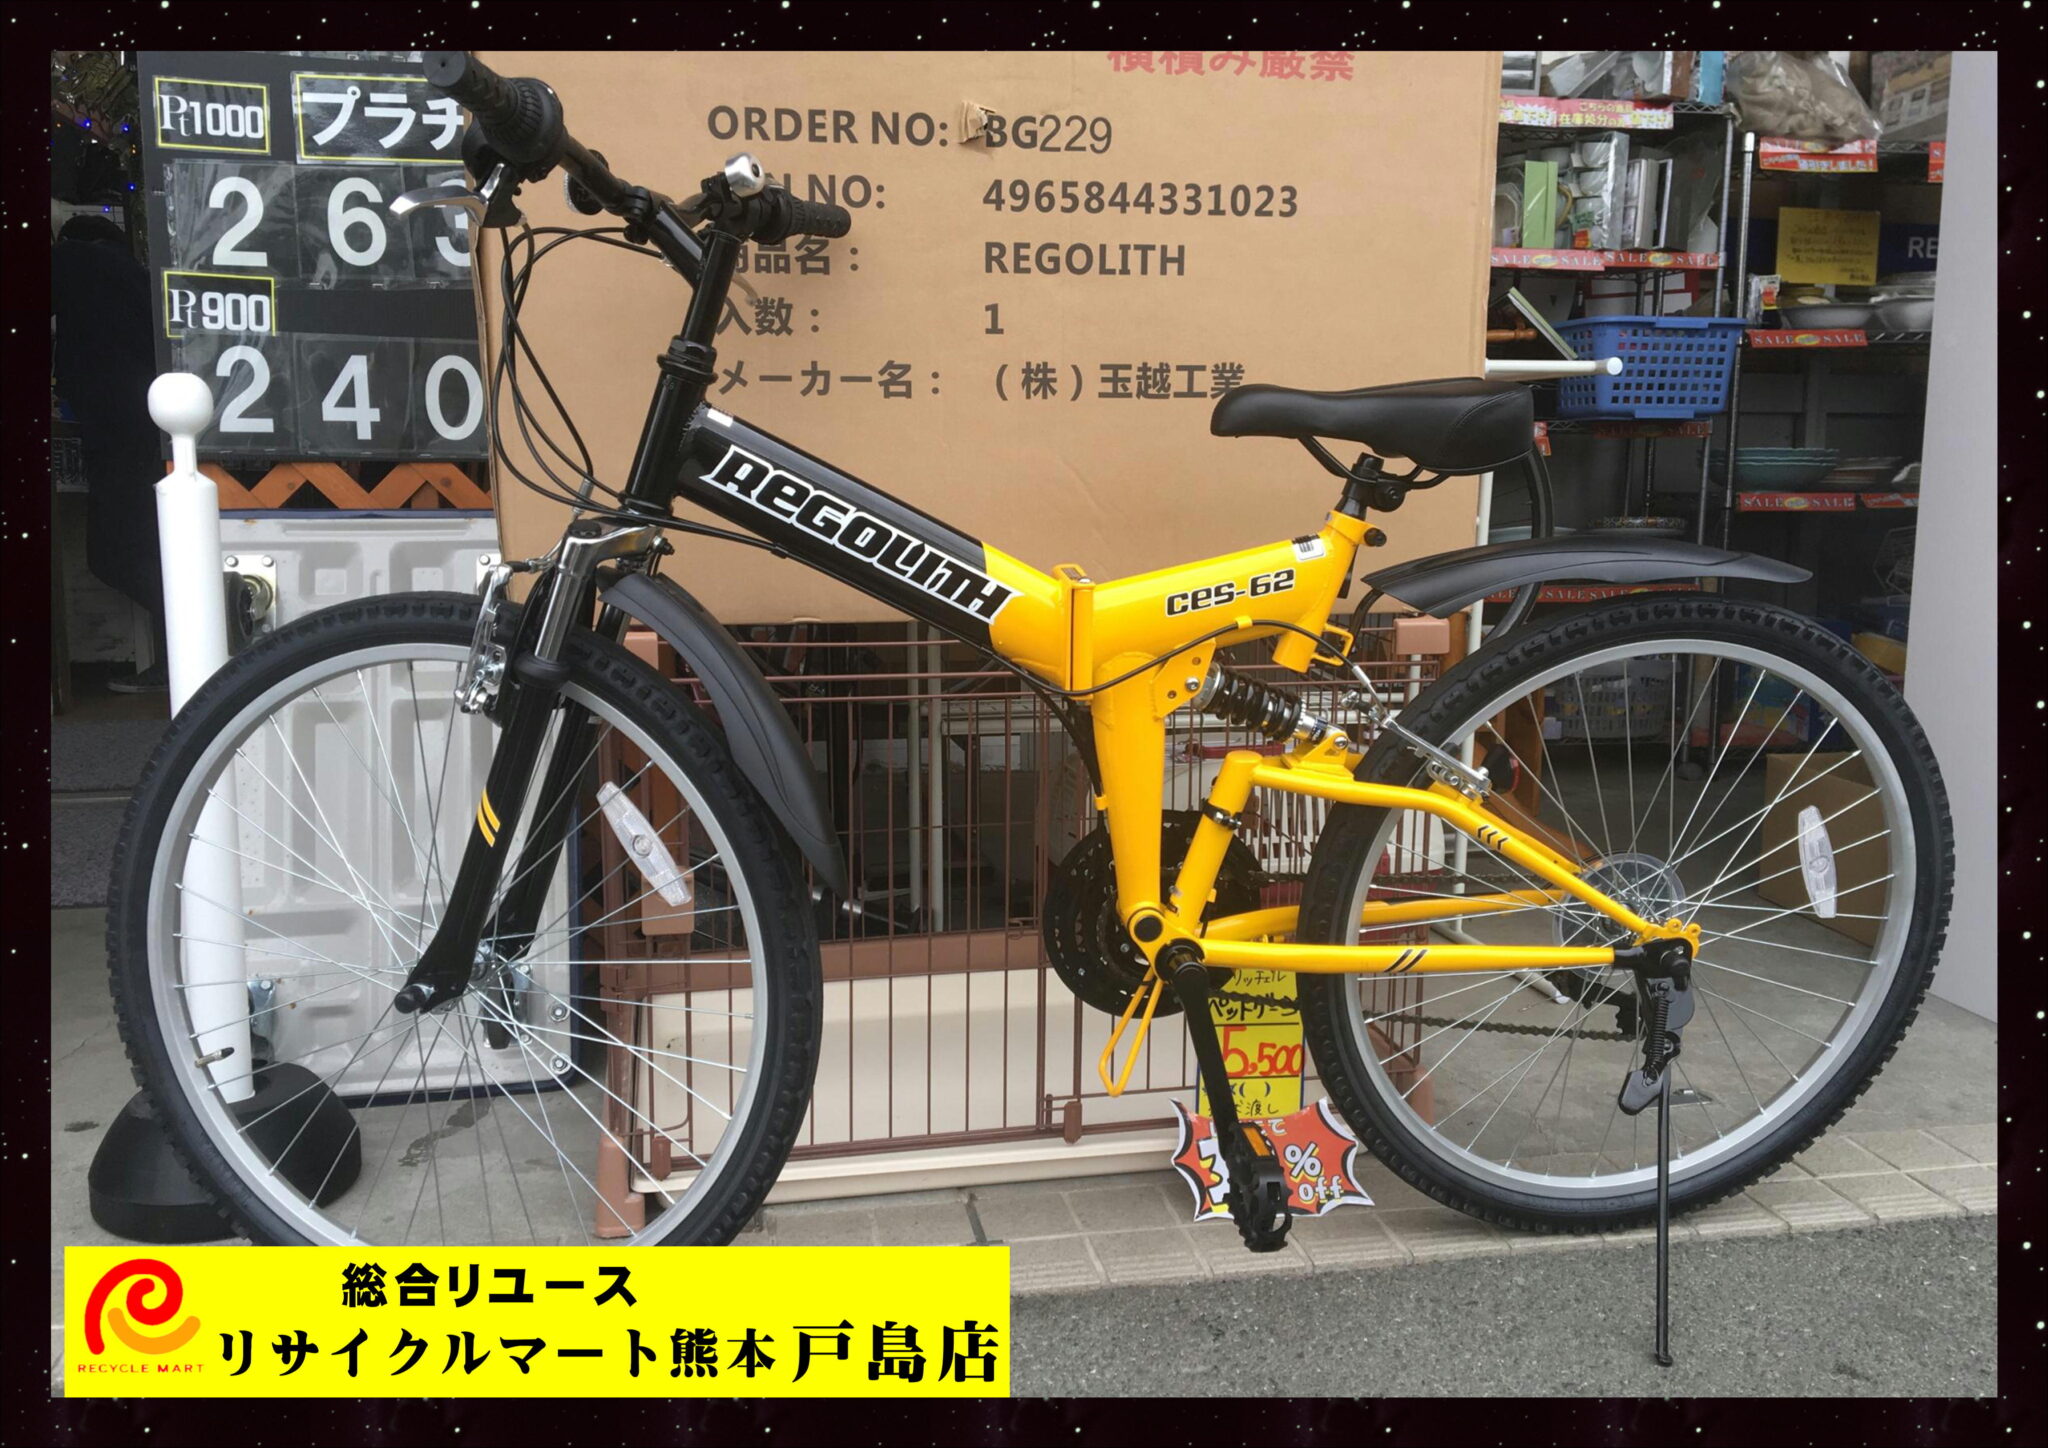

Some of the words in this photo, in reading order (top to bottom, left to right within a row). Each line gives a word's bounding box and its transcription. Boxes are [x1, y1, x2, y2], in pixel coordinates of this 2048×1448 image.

[302, 85, 464, 151] プラチ
[707, 106, 858, 143] ORDER
[871, 111, 949, 147] NO:
[984, 115, 1112, 154] BG229
[808, 174, 885, 209] NO:
[982, 180, 1299, 218] 4965844331023
[984, 243, 1186, 276] REGOLITH
[1560, 255, 1600, 267] SALE
[1606, 250, 1647, 263] SALE
[984, 304, 1004, 334] 1
[1754, 335, 1794, 345] SALE
[1823, 334, 1864, 344] SALE
[216, 345, 484, 441] 240
[718, 360, 940, 399] メーカー名：
[1744, 496, 1783, 508] SALE
[1812, 496, 1855, 508] SALE
[1545, 590, 1586, 600] SALE
[1298, 1176, 1344, 1202] off
